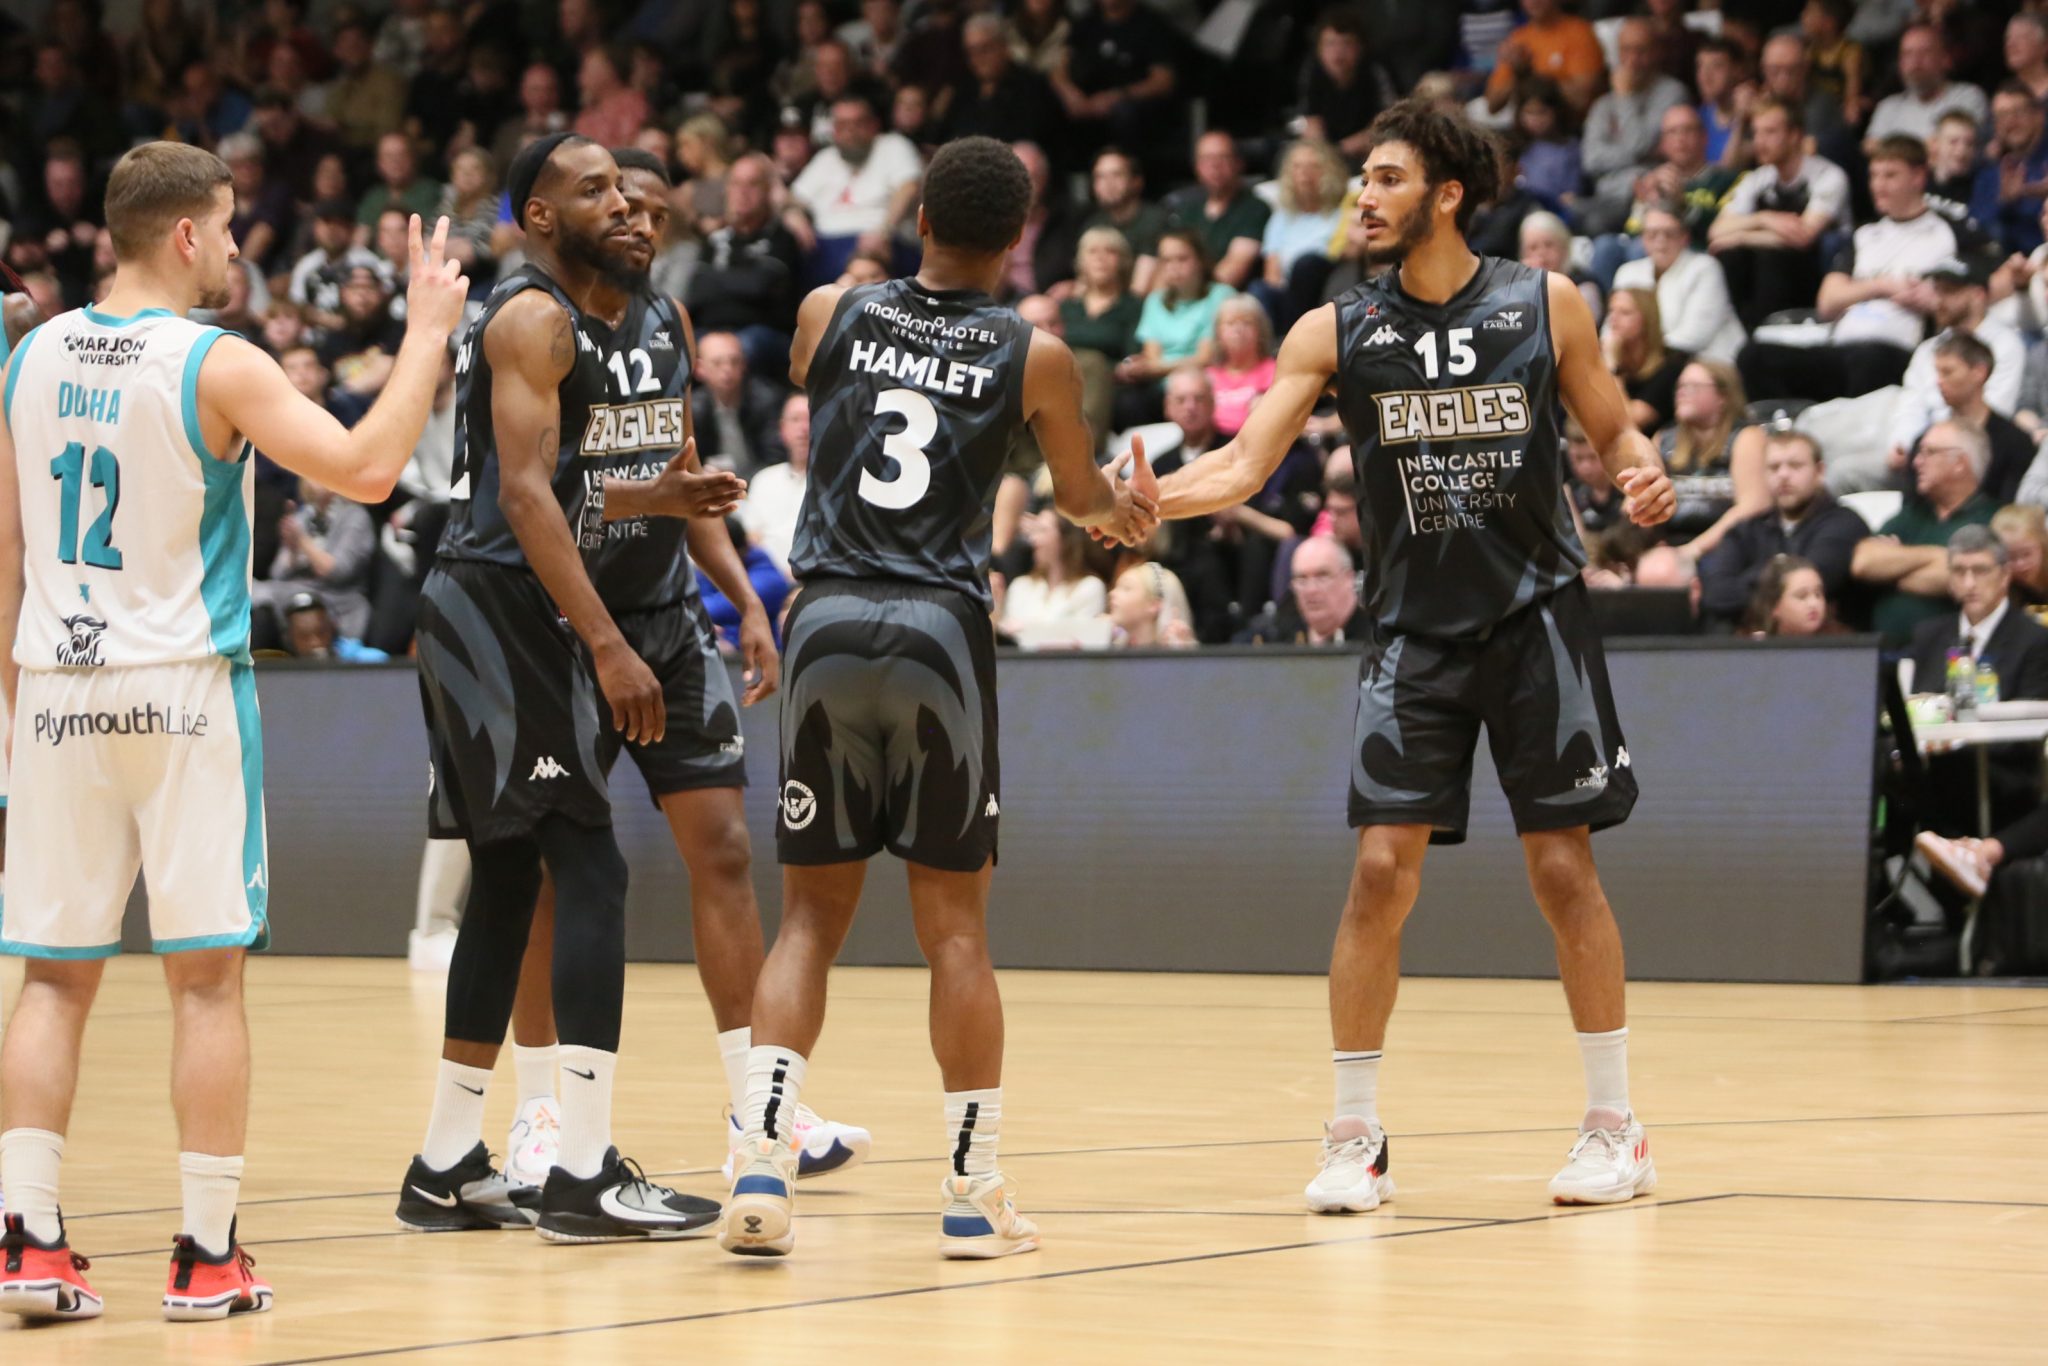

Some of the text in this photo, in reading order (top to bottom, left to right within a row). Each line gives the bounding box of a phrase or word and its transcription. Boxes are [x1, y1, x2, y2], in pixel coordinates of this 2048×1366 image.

[75, 335, 147, 353] MARJON
[891, 326, 964, 351] NEWCASTLE
[941, 326, 998, 345] HOTEL
[78, 353, 141, 366] NIVERSITY
[1413, 327, 1477, 379] 15
[607, 348, 662, 396] 12
[849, 339, 994, 399] HAMLET
[1377, 385, 1529, 442] EAGLES
[858, 388, 938, 510] 3
[1405, 450, 1523, 473] NEWCASTLE
[1410, 472, 1496, 493] COLLEGE
[50, 441, 123, 570] 12
[1415, 493, 1517, 513] UNIVERSITY
[1419, 513, 1486, 533] CENTRE
[35, 702, 208, 746] PlymouthLive
